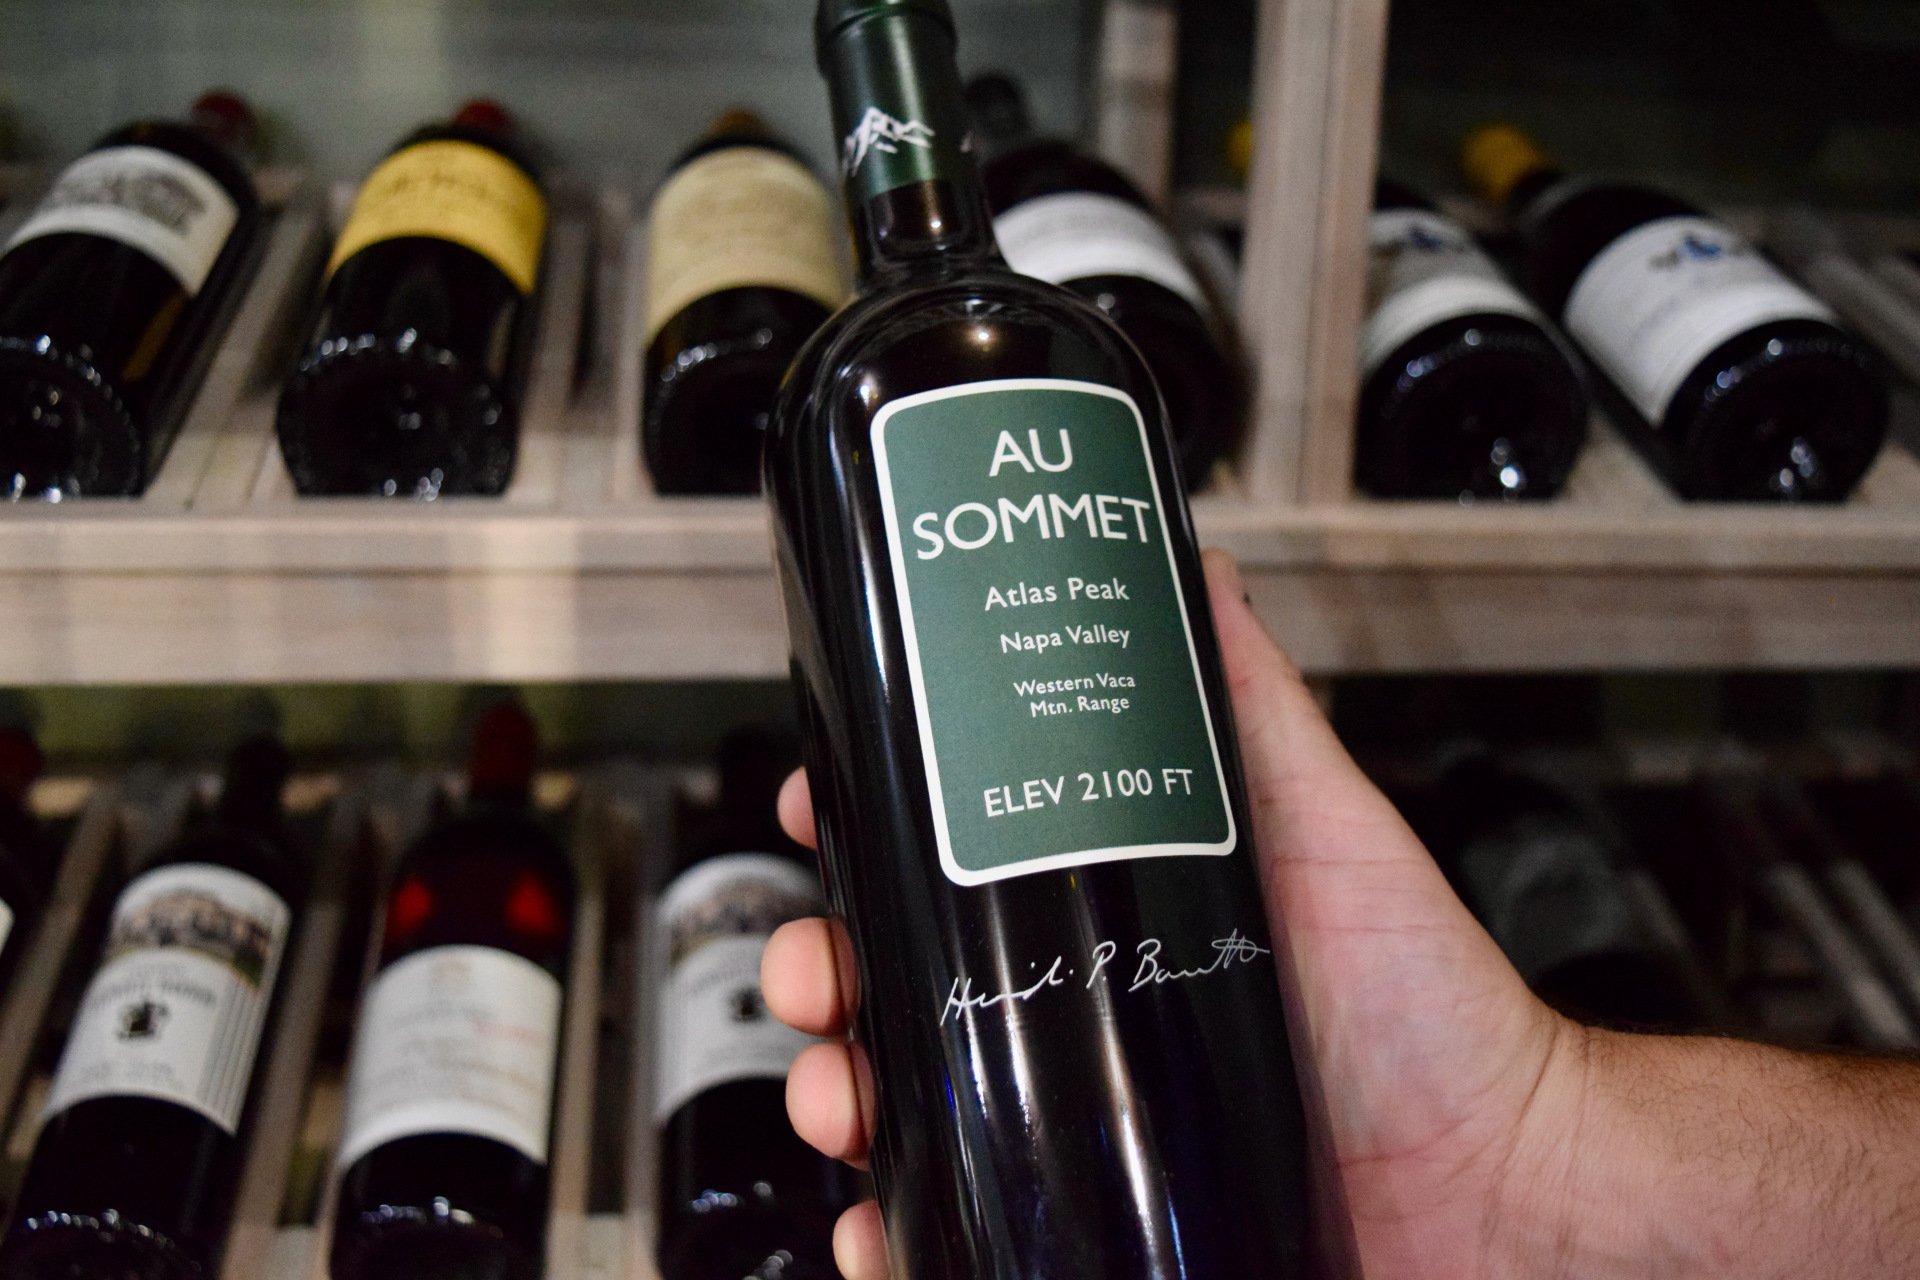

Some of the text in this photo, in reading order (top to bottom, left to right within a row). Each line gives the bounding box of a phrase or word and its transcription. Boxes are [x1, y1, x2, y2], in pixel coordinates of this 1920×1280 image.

[989, 428, 1074, 477] AU
[912, 493, 1150, 560] SOMMET
[984, 576, 1130, 611] Atlas Peak
[1000, 624, 1131, 654] Napa Valley
[1013, 672, 1136, 697] Western Vaca
[1030, 694, 1131, 718] Mtn. Range
[983, 768, 1193, 818] ELEV 2100 FT
